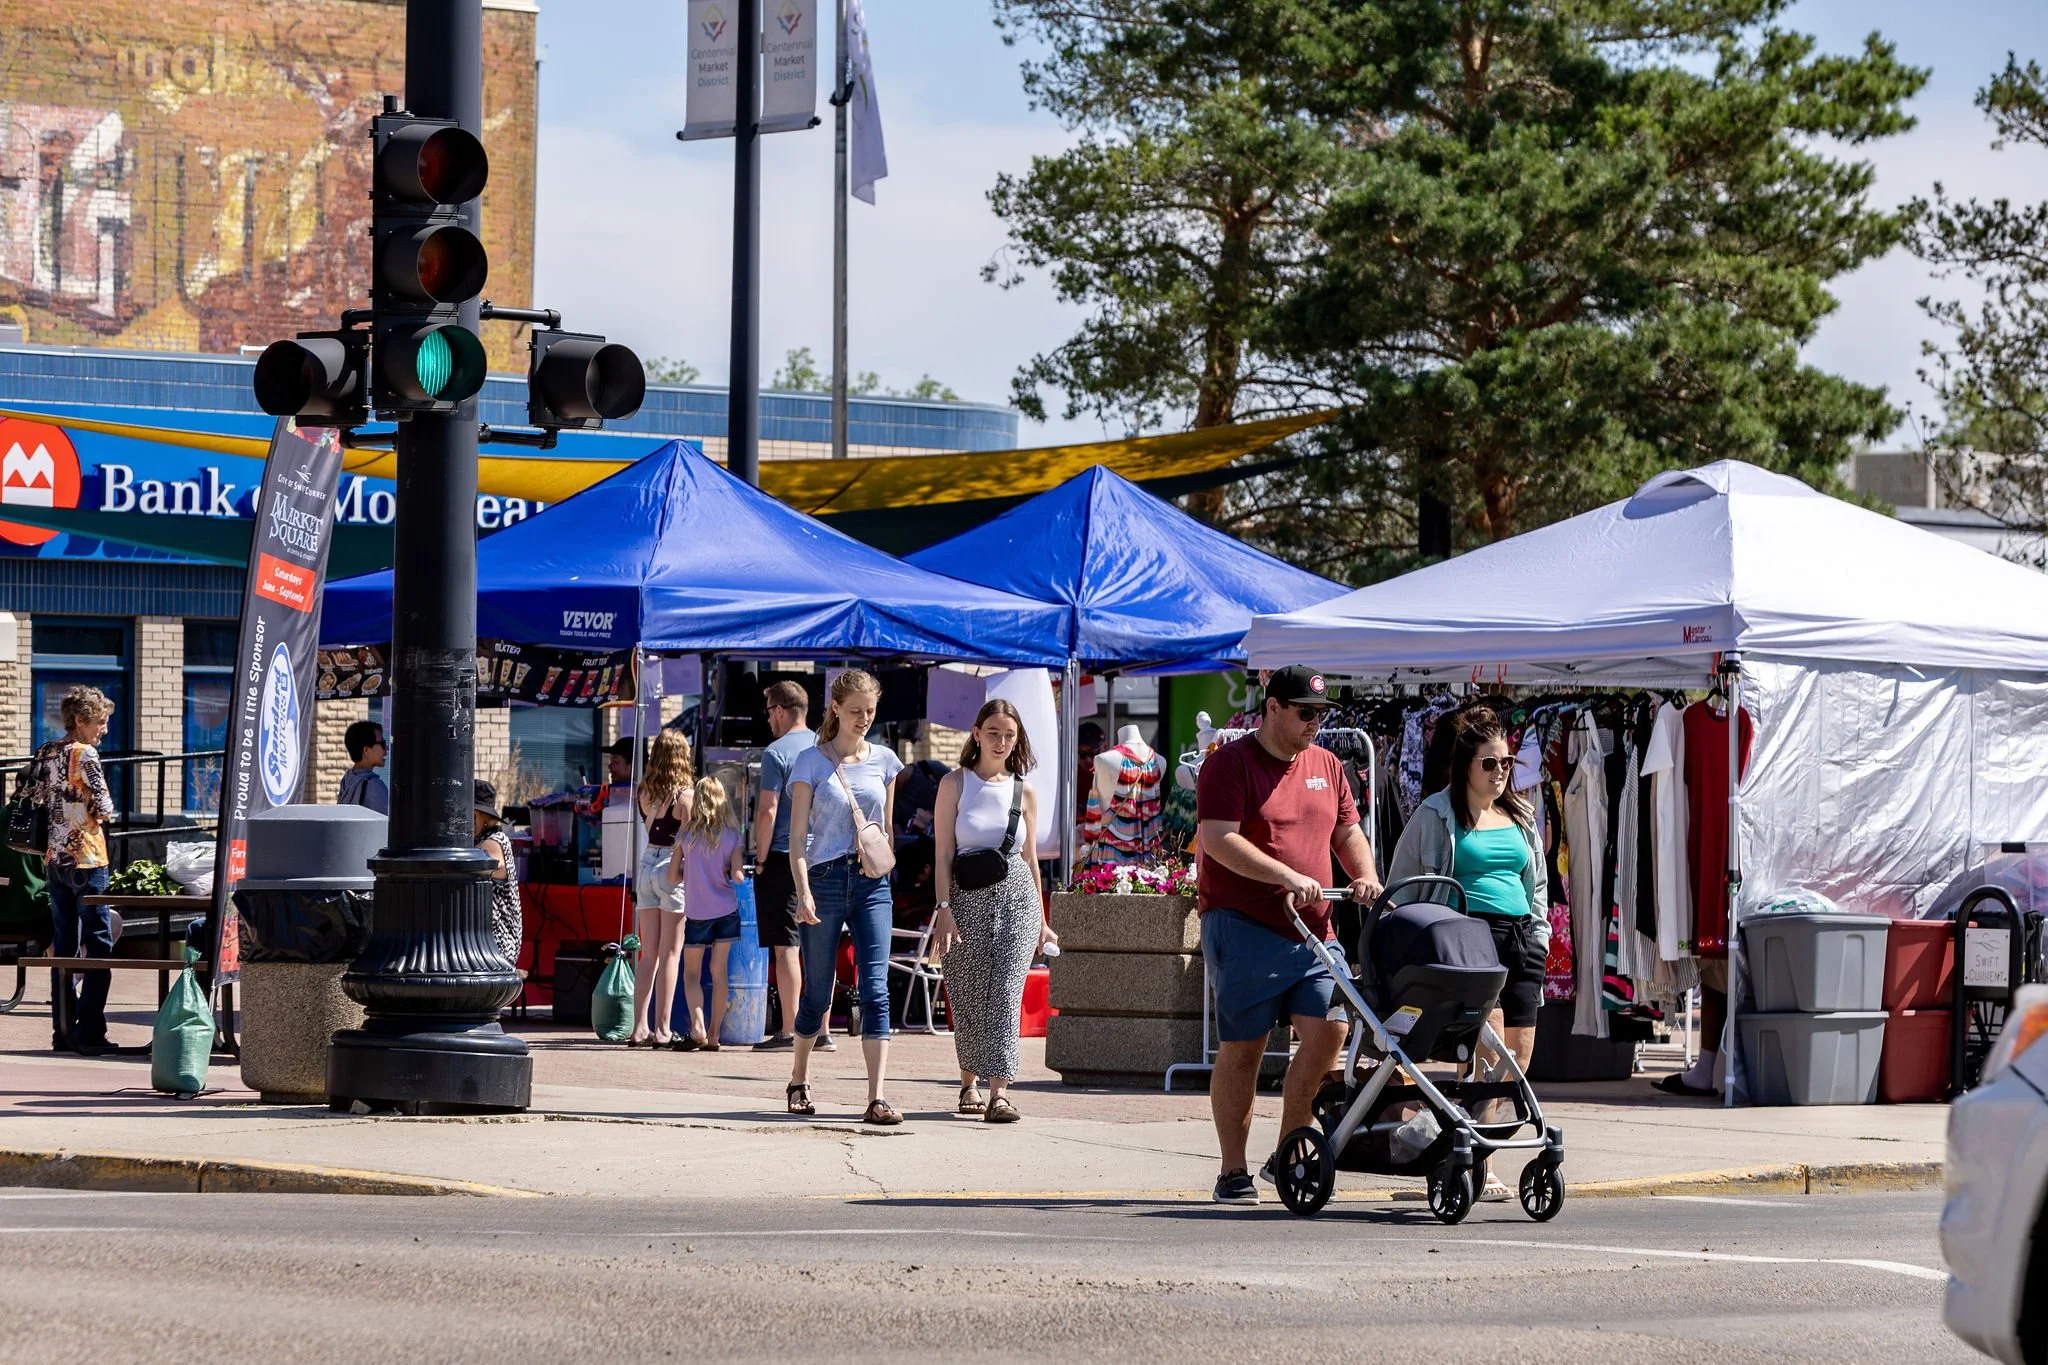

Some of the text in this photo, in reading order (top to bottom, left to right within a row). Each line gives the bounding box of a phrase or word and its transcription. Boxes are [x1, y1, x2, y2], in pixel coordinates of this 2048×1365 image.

[766, 38, 813, 53] Centennial
[698, 61, 728, 73] Market
[774, 55, 805, 67] Market
[697, 76, 728, 88] District
[773, 70, 806, 82] District
[100, 463, 239, 517] Bank
[334, 475, 545, 529] Moea
[304, 486, 327, 500] CURRET
[269, 491, 324, 535] MARKET
[268, 512, 318, 553] SQUARE
[274, 566, 303, 586] Saturdays
[262, 578, 276, 593] June
[563, 610, 614, 630] VEVOR
[249, 615, 266, 683] Sponsor
[582, 658, 599, 667] FRUIT
[268, 665, 282, 788] Standard
[279, 692, 288, 769] MOTORS
[242, 728, 254, 747] be
[239, 751, 252, 768] to
[233, 771, 250, 820] Proud
[1975, 954, 1999, 968] SWIFT
[1968, 968, 2005, 982] CURRENT
